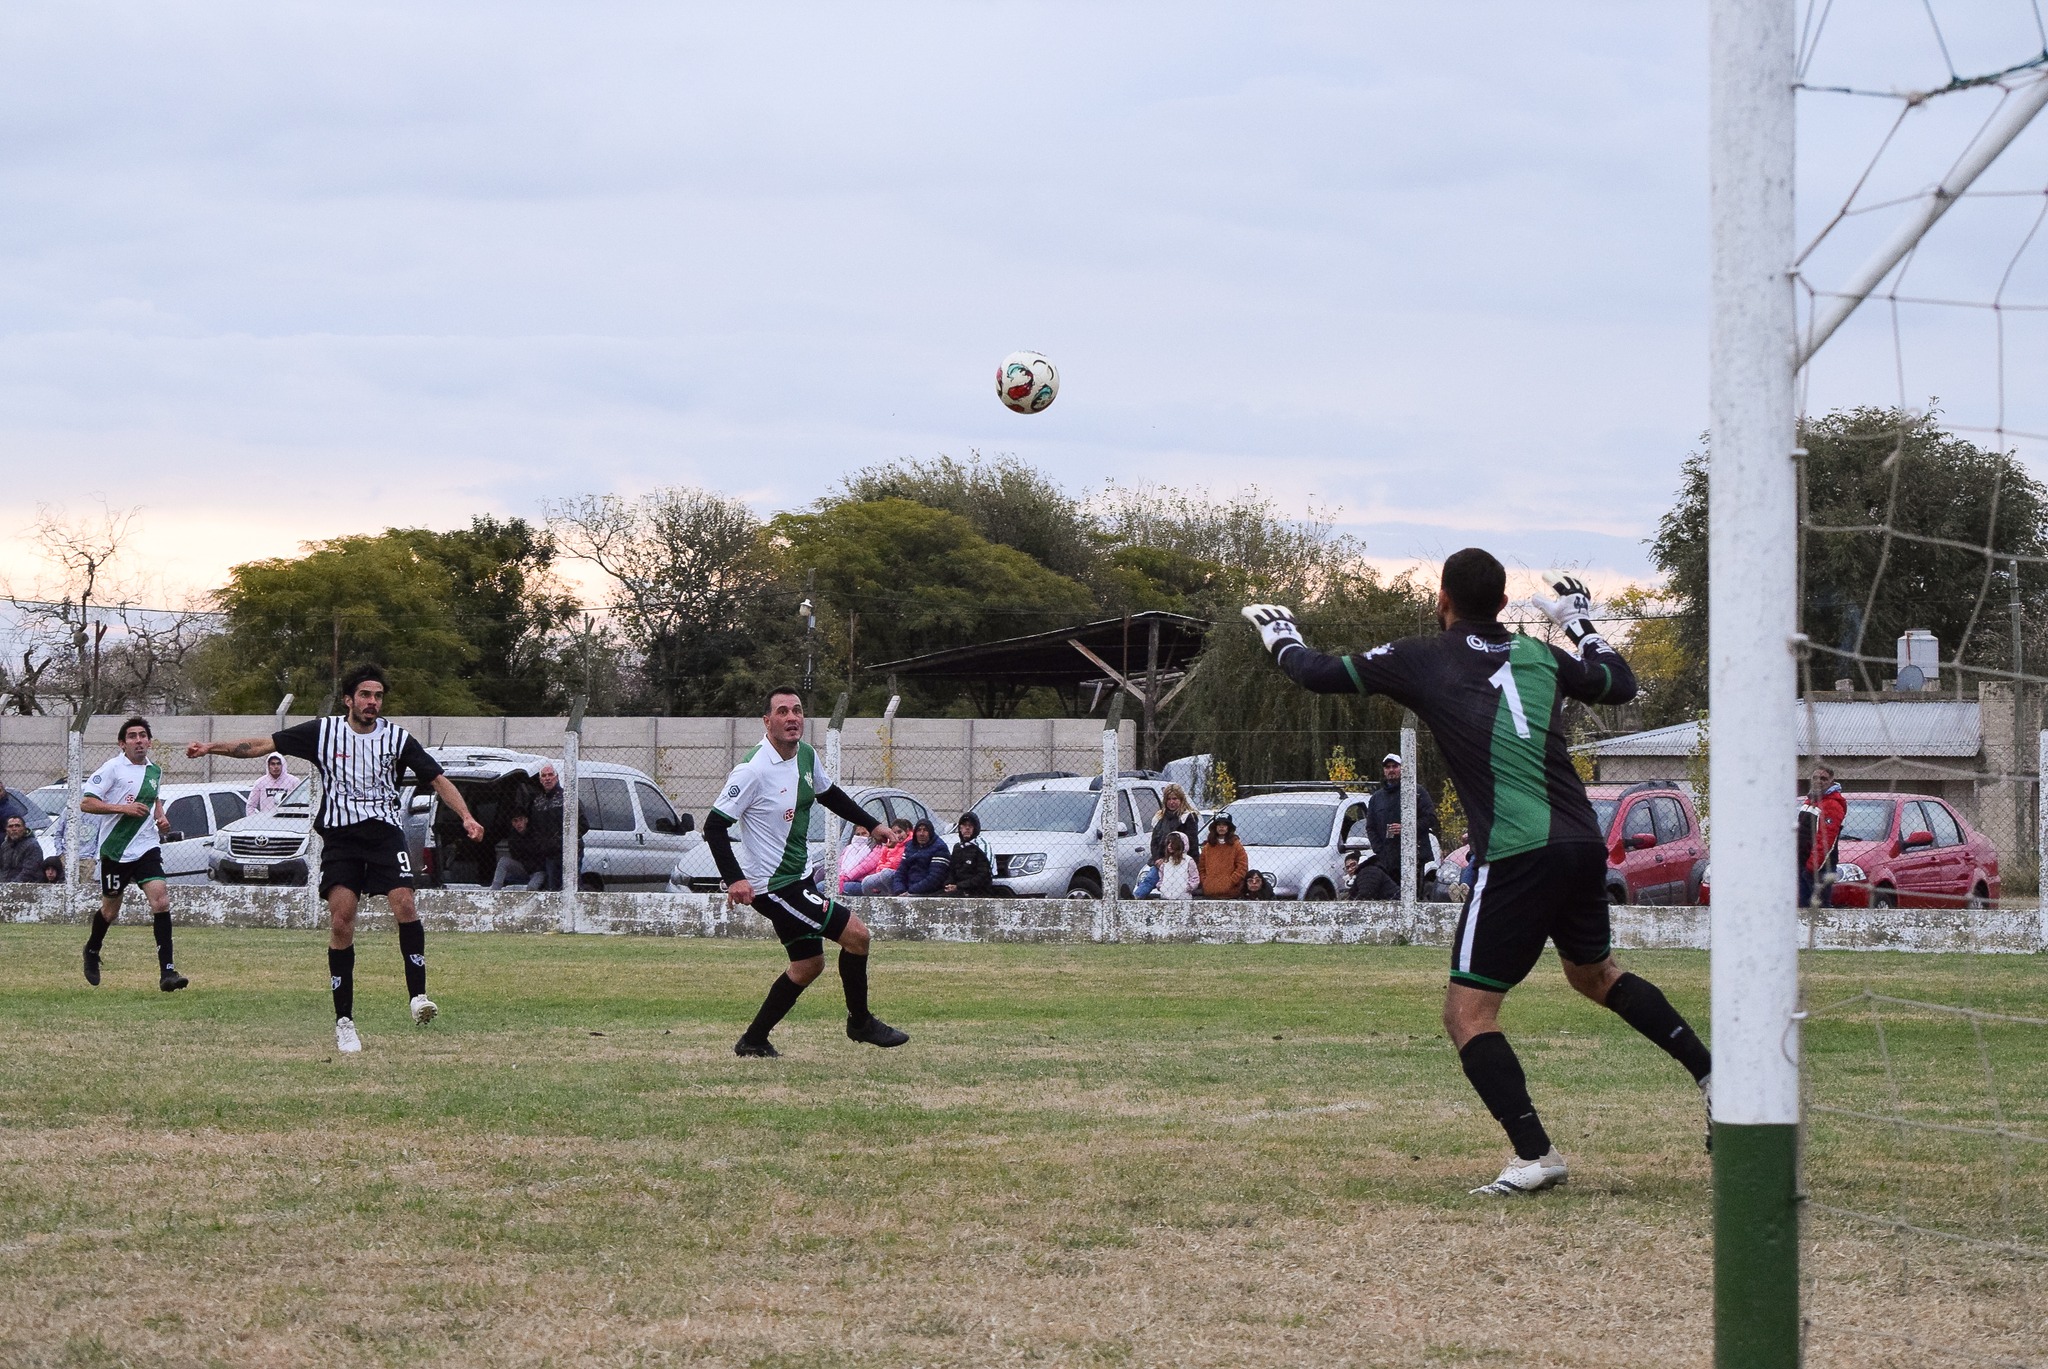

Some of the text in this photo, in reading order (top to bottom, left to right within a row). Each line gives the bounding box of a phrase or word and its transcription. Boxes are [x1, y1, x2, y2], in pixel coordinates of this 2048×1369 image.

[1488, 661, 1531, 738] 1
[397, 851, 411, 872] 9
[106, 873, 121, 890] 15
[803, 889, 823, 905] 6
